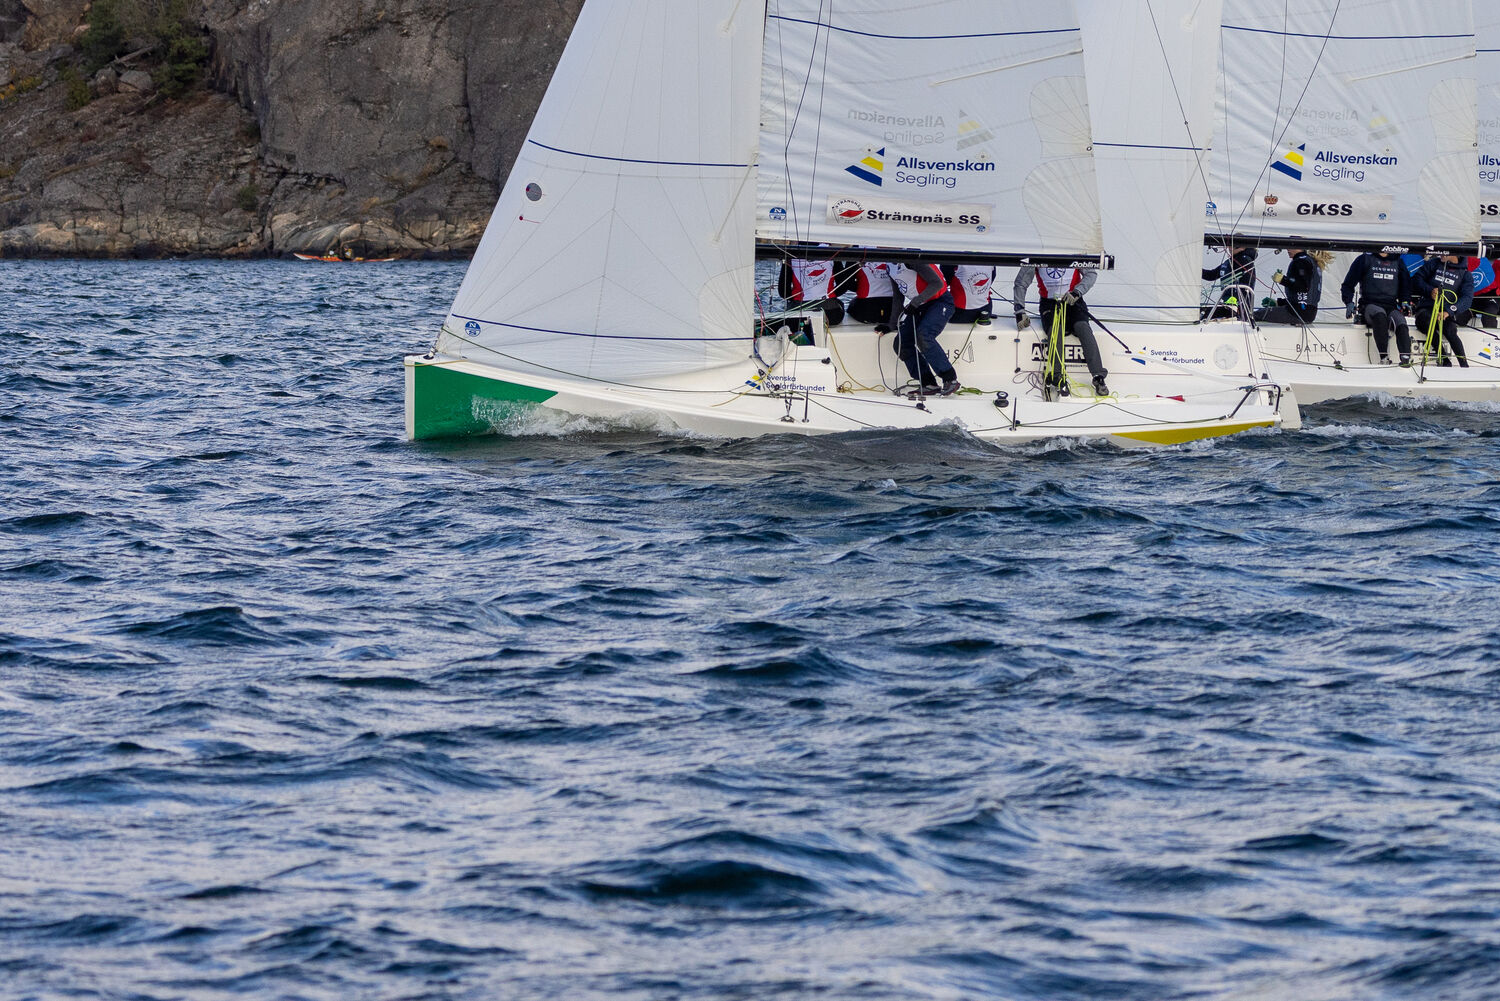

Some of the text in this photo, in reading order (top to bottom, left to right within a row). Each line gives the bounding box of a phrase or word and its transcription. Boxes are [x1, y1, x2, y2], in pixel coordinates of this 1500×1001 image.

[896, 157, 995, 171] Allsvenskan
[1314, 151, 1398, 165] Allsvenskan
[895, 171, 957, 189] Segling
[1313, 165, 1365, 182] Segling
[1296, 203, 1353, 216] GKSS
[866, 210, 953, 224] Strängnäs
[958, 214, 980, 225] SS
[1381, 245, 1409, 253] Robline
[1296, 343, 1335, 353] BATHS
